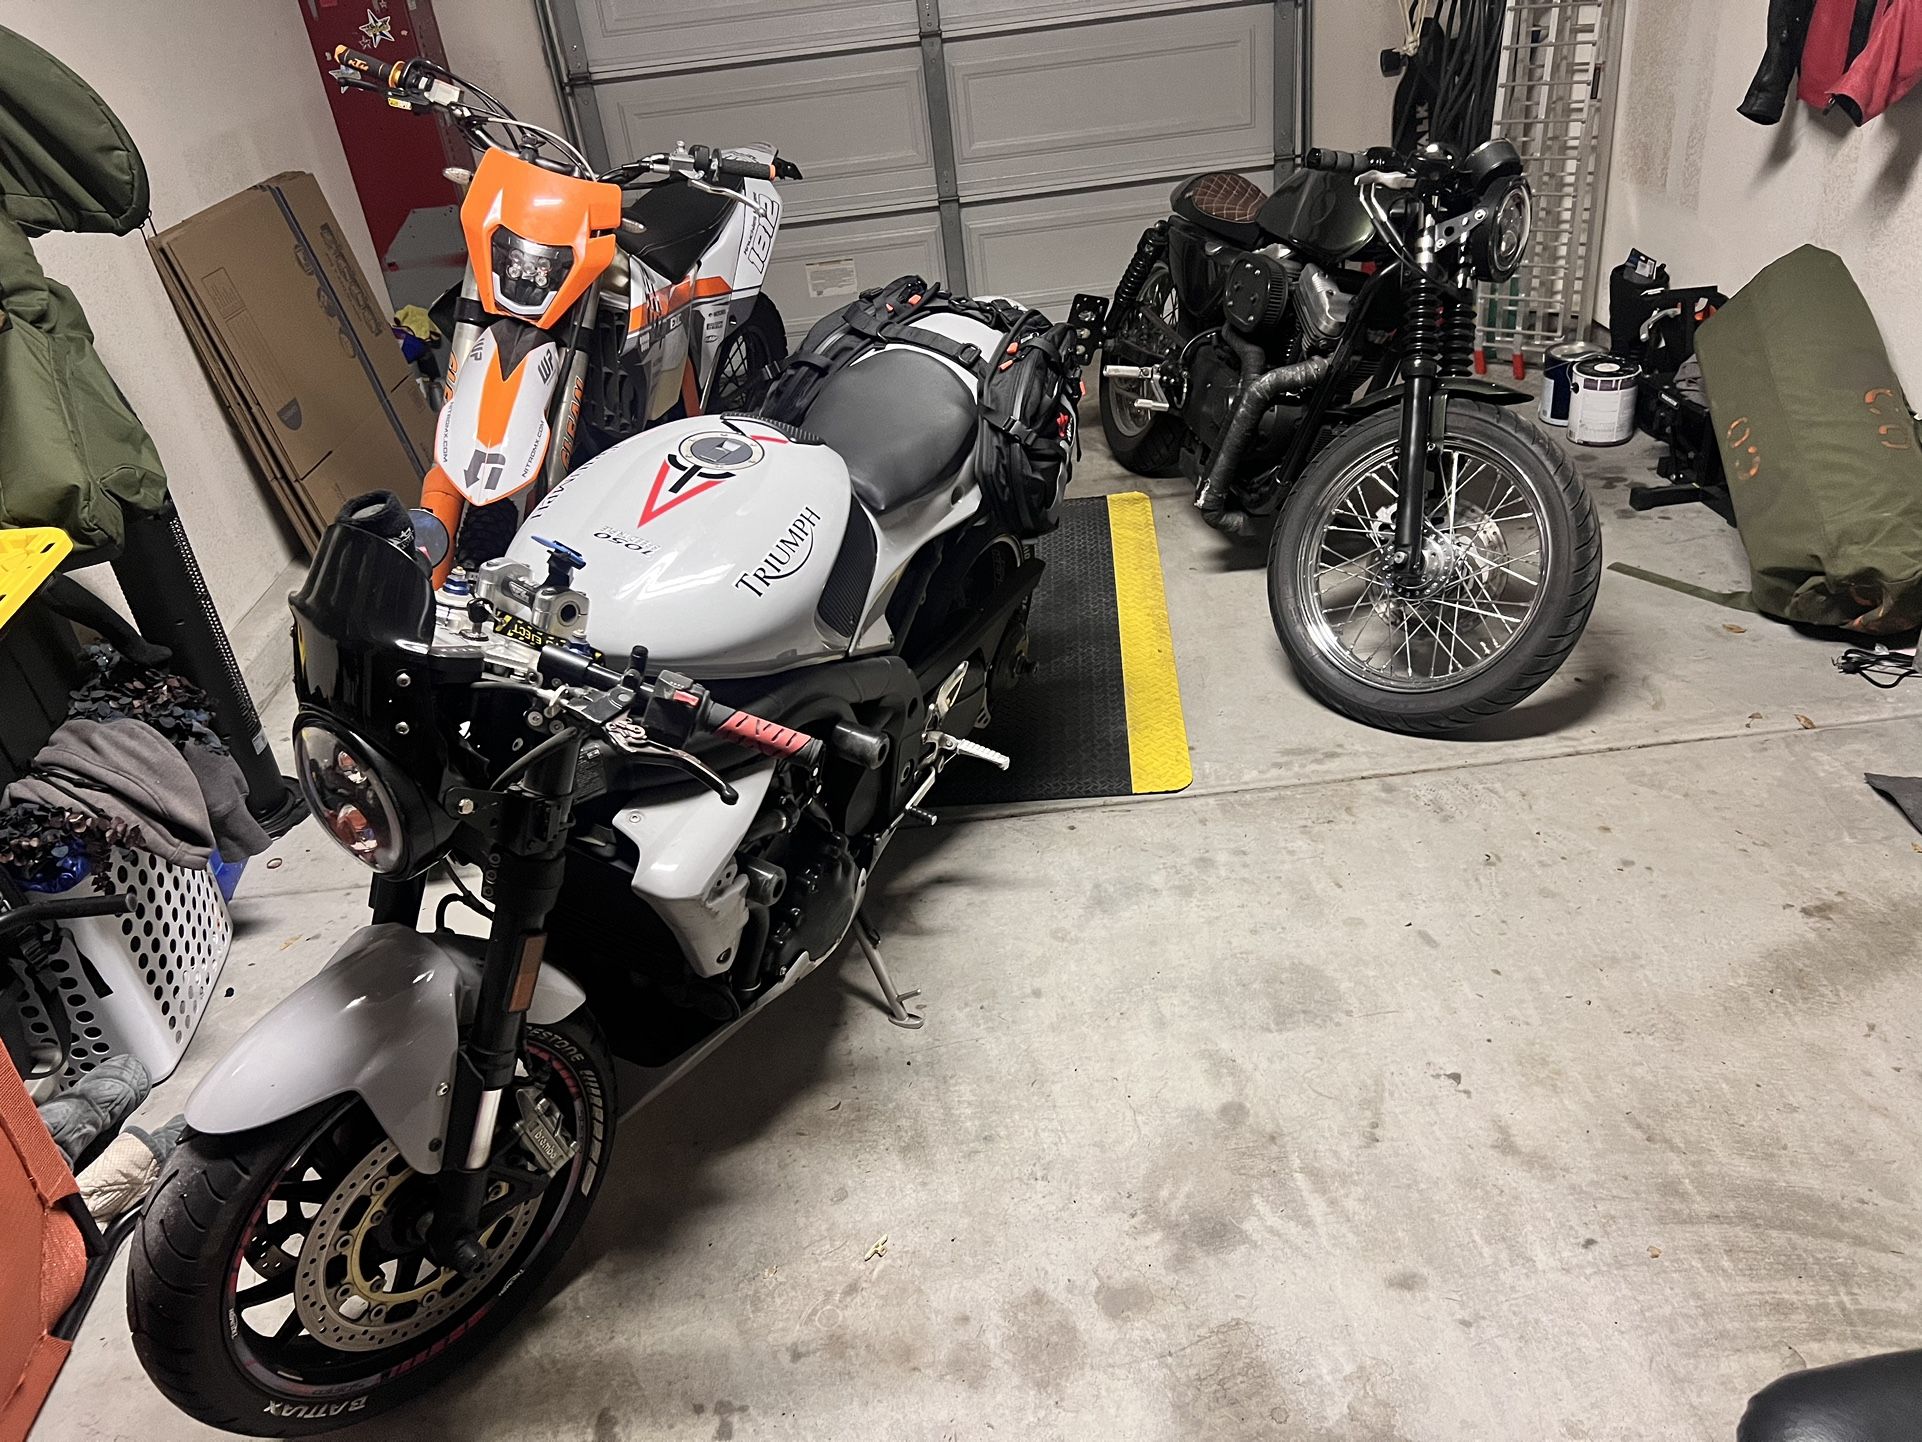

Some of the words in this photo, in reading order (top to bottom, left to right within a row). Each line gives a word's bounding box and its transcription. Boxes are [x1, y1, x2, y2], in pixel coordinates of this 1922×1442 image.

[748, 193, 780, 274] 1812
[538, 348, 555, 384] WP
[522, 420, 545, 478] NITROMX.COM
[593, 532, 653, 554] 1050
[735, 506, 821, 599] TRIUMPH
[511, 623, 542, 645] EJECT
[534, 1128, 557, 1159] brembo
[264, 1395, 369, 1419] BATTLAX
